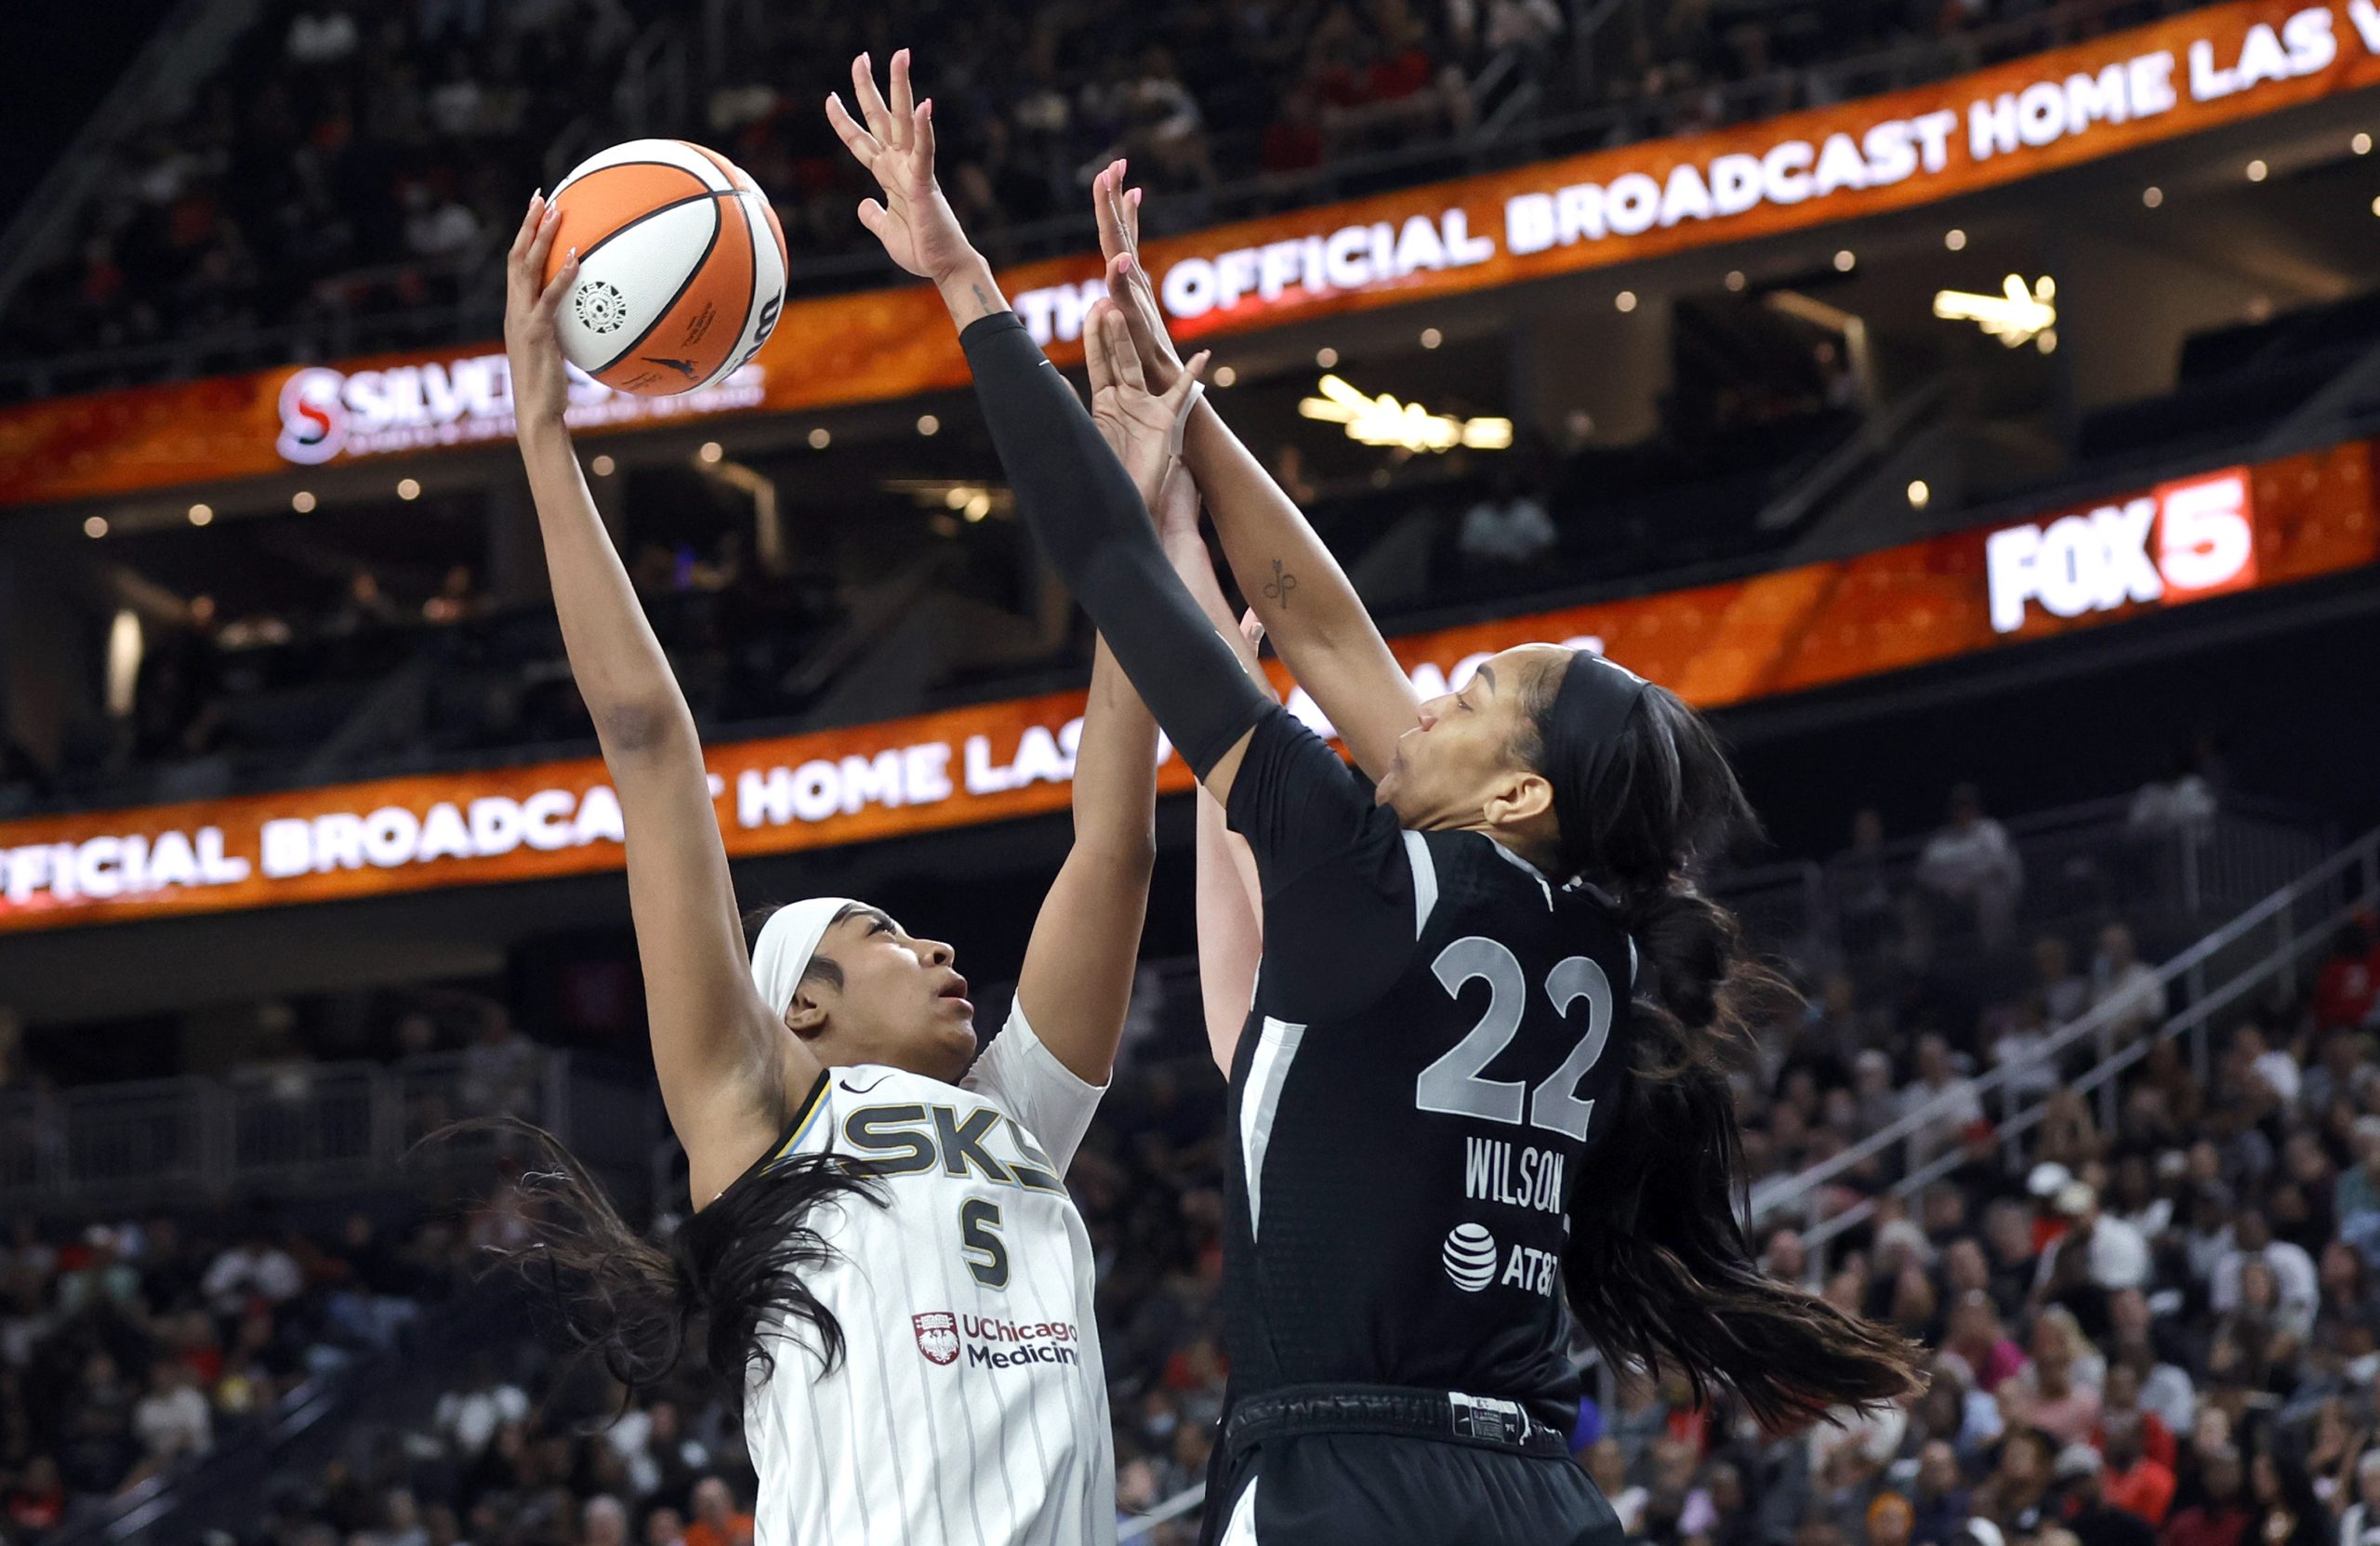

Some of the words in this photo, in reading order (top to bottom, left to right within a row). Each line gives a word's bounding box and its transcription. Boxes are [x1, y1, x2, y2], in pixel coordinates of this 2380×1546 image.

[1012, 273, 1151, 348] TH
[1163, 208, 1495, 319] OFFICIAL
[1505, 110, 1958, 254] BROADCAST
[1968, 50, 2177, 161] HOME
[2188, 7, 2336, 102] LAS
[1986, 496, 2164, 634] FOX
[2160, 477, 2252, 589] 5
[0, 827, 250, 905] FICIAL
[260, 774, 725, 879] BROADCA
[737, 742, 952, 828] HOME
[1416, 936, 1613, 1143] 22
[1465, 1136, 1565, 1214] WILSON
[959, 1196, 1011, 1292] 5
[962, 1314, 1078, 1342] UChicago
[967, 1341, 1078, 1370] Medicin
